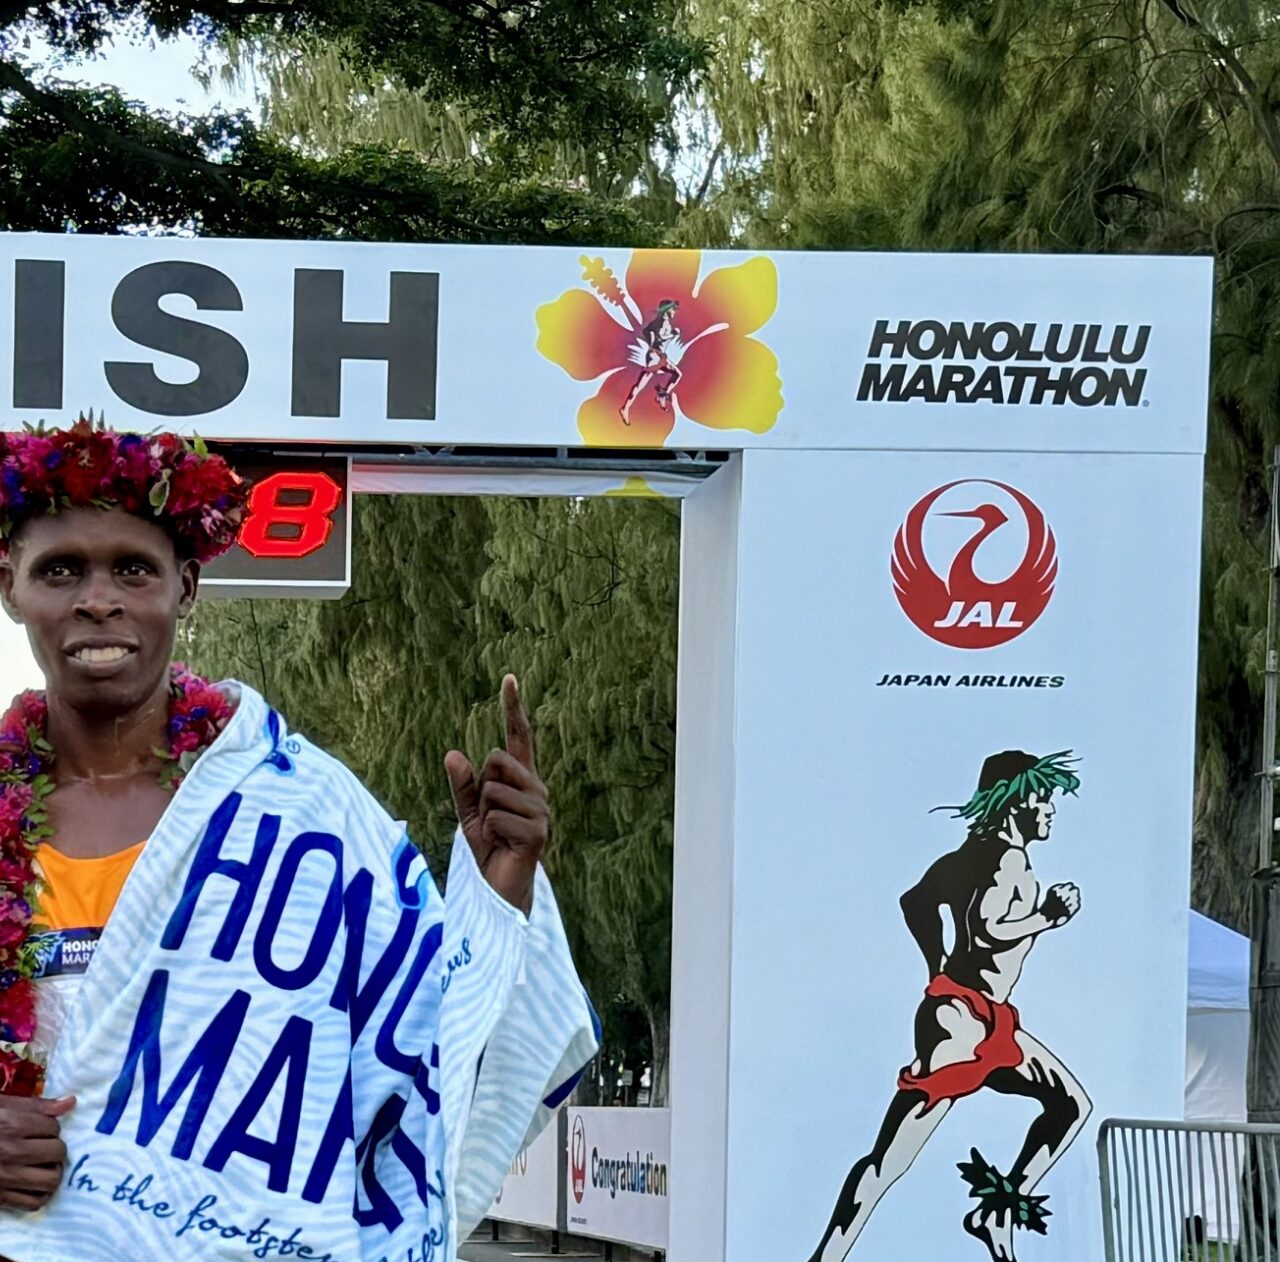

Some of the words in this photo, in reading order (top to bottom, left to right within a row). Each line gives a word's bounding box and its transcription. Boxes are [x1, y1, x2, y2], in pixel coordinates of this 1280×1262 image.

[868, 320, 1151, 364] HONOLULU
[856, 364, 1148, 407] MARATHON
[934, 600, 1023, 628] JAL
[876, 673, 952, 687] JAPAN
[956, 674, 1065, 688] AIRLINES
[67, 1154, 99, 1192] In
[114, 1173, 176, 1218] the
